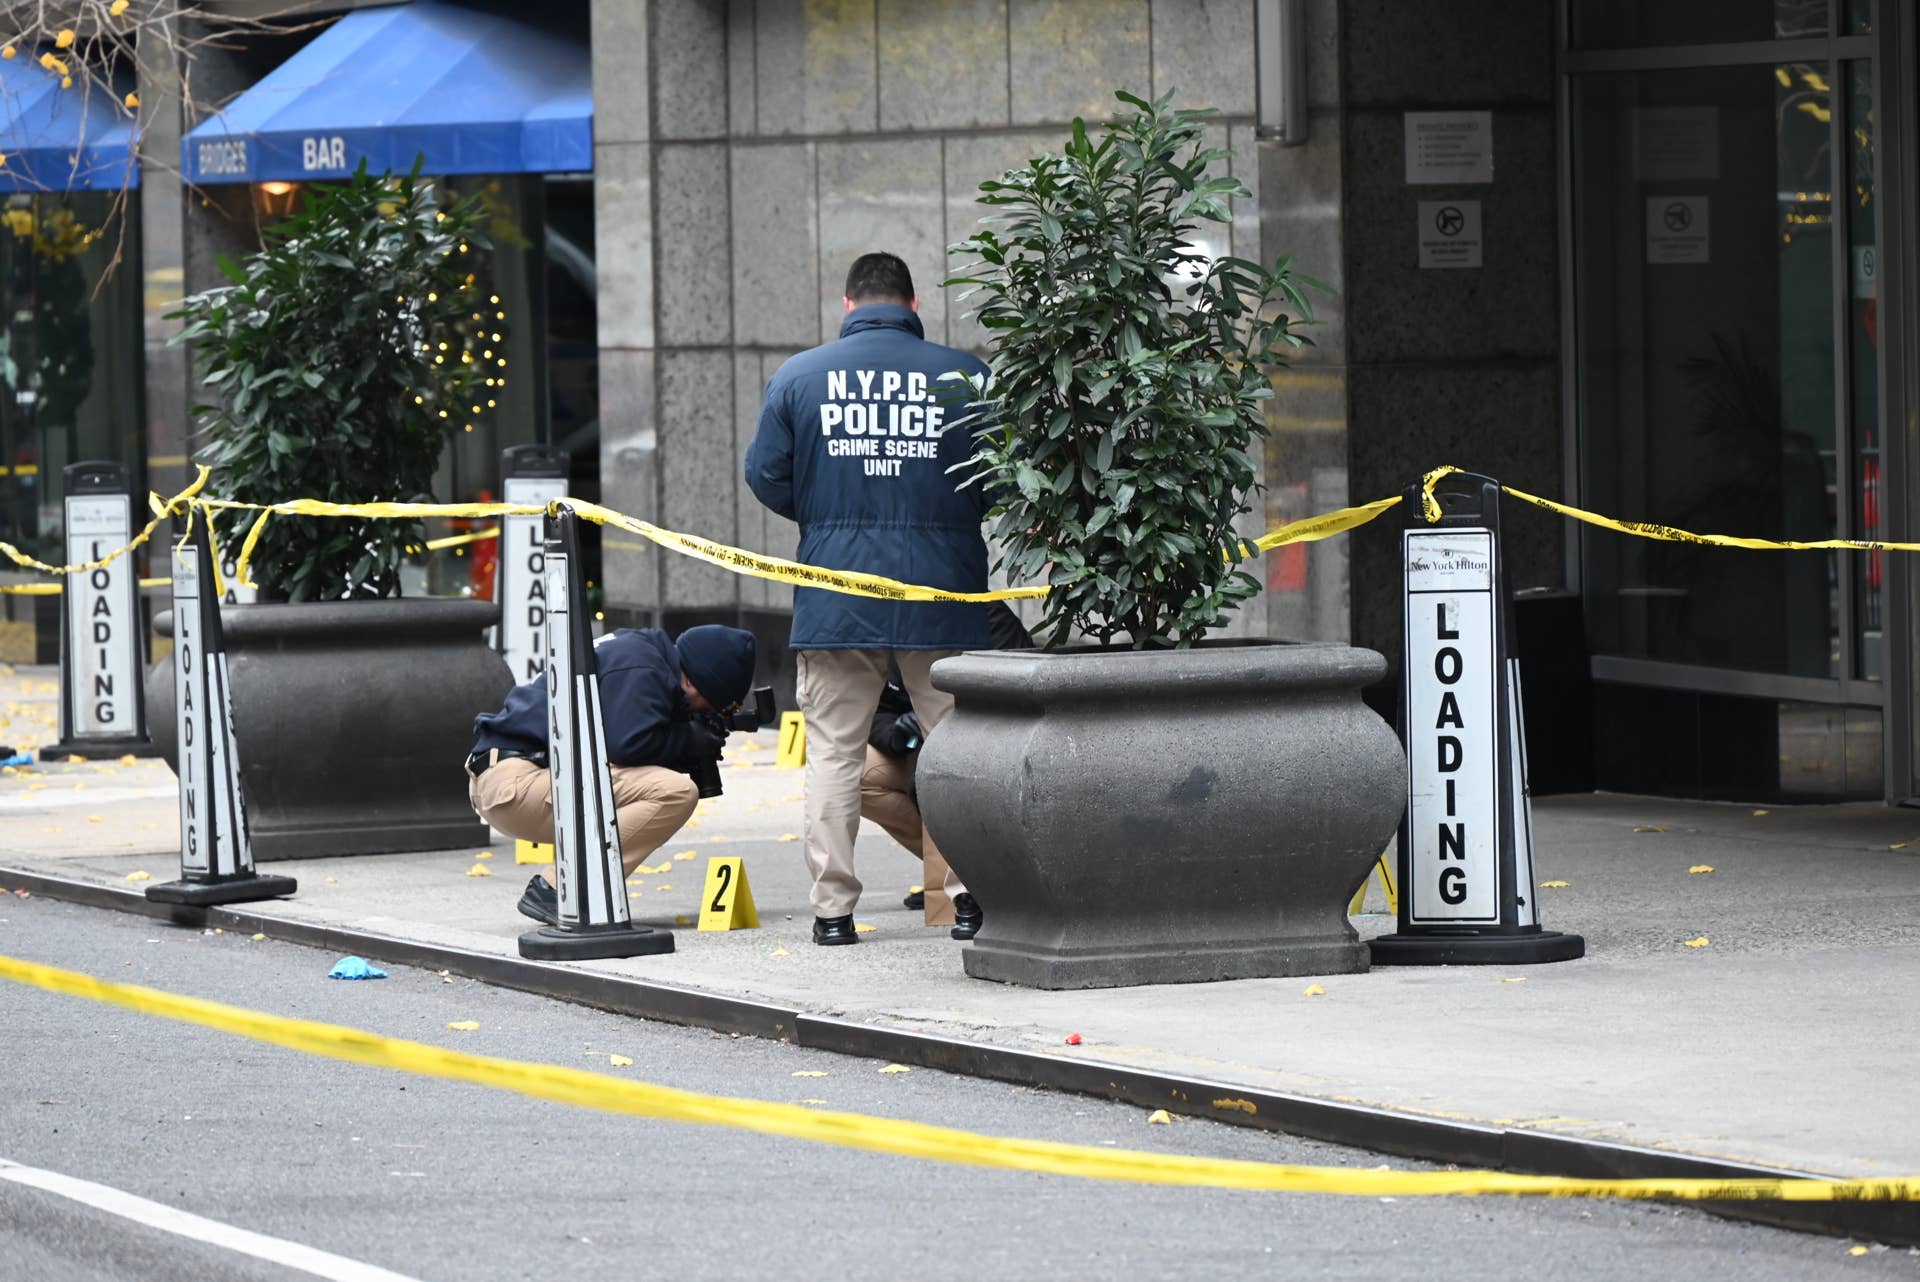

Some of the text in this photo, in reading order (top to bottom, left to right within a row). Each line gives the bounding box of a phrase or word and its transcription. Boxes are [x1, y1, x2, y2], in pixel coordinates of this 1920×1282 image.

[199, 140, 247, 175] BRIDGES
[303, 136, 346, 171] BAR
[827, 369, 937, 403] N.Y.P.D.
[820, 402, 945, 438] POLICE
[827, 438, 938, 459] CRIME SCENE
[863, 458, 903, 477] UNIT
[1410, 560, 1488, 571] New York Hilton
[527, 524, 545, 681] LOADIN
[91, 540, 115, 724] LOADING
[181, 607, 198, 857] LOADING
[786, 720, 799, 755] 7
[1435, 603, 1468, 905] LOADING
[710, 864, 732, 913] 2
